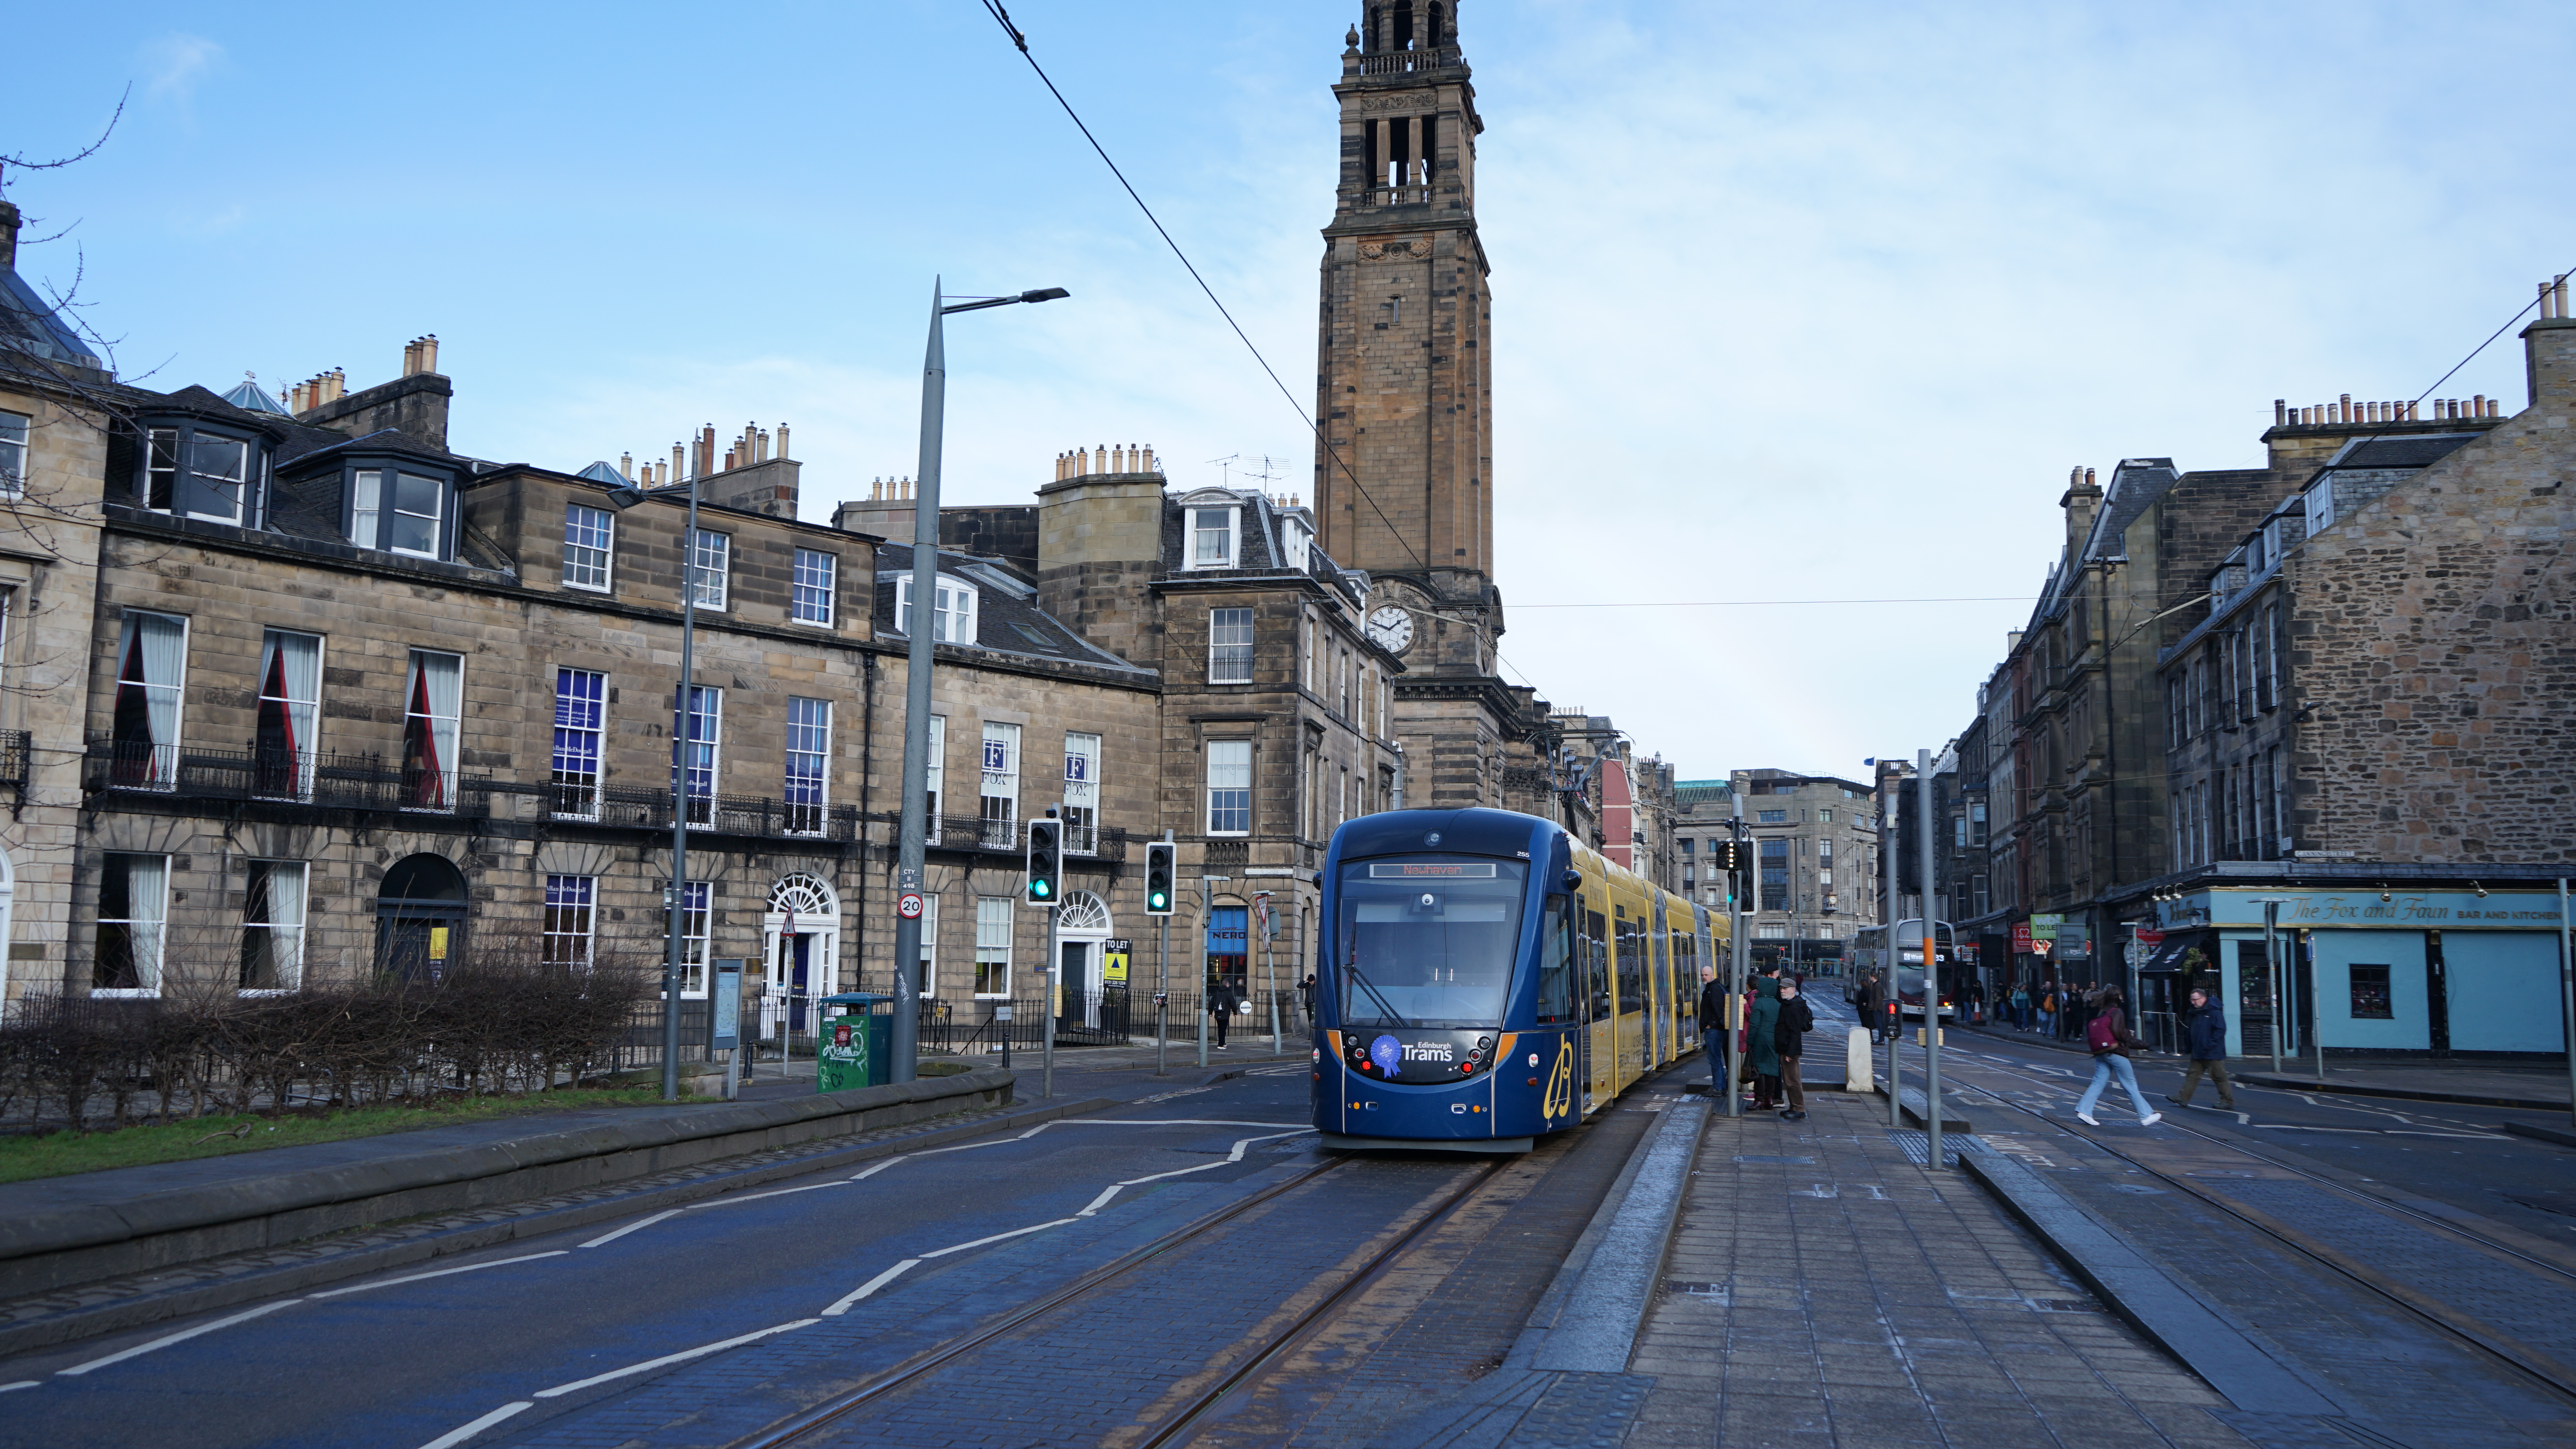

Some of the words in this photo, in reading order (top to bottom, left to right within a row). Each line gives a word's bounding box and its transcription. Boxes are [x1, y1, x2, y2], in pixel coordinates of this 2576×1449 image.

[566, 746, 592, 755] McDogall
[981, 772, 1007, 785] FOX
[687, 779, 708, 788] cDogall
[1064, 784, 1087, 797] FOX
[1403, 865, 1462, 875] Newhaven
[903, 901, 920, 911] 20
[1258, 898, 1267, 906] GIVE
[2287, 897, 2320, 919] The
[2323, 897, 2359, 919] Fox
[2364, 899, 2400, 918] and
[2401, 897, 2448, 920] Faun
[2458, 910, 2481, 919] BAR
[2484, 911, 2509, 919] AND
[2512, 911, 2562, 919] KITCHEN
[1107, 940, 1115, 949] TO
[1116, 940, 1128, 949] LET
[1418, 1042, 1451, 1050] Edinburgh
[1401, 1045, 1452, 1062] Trams
